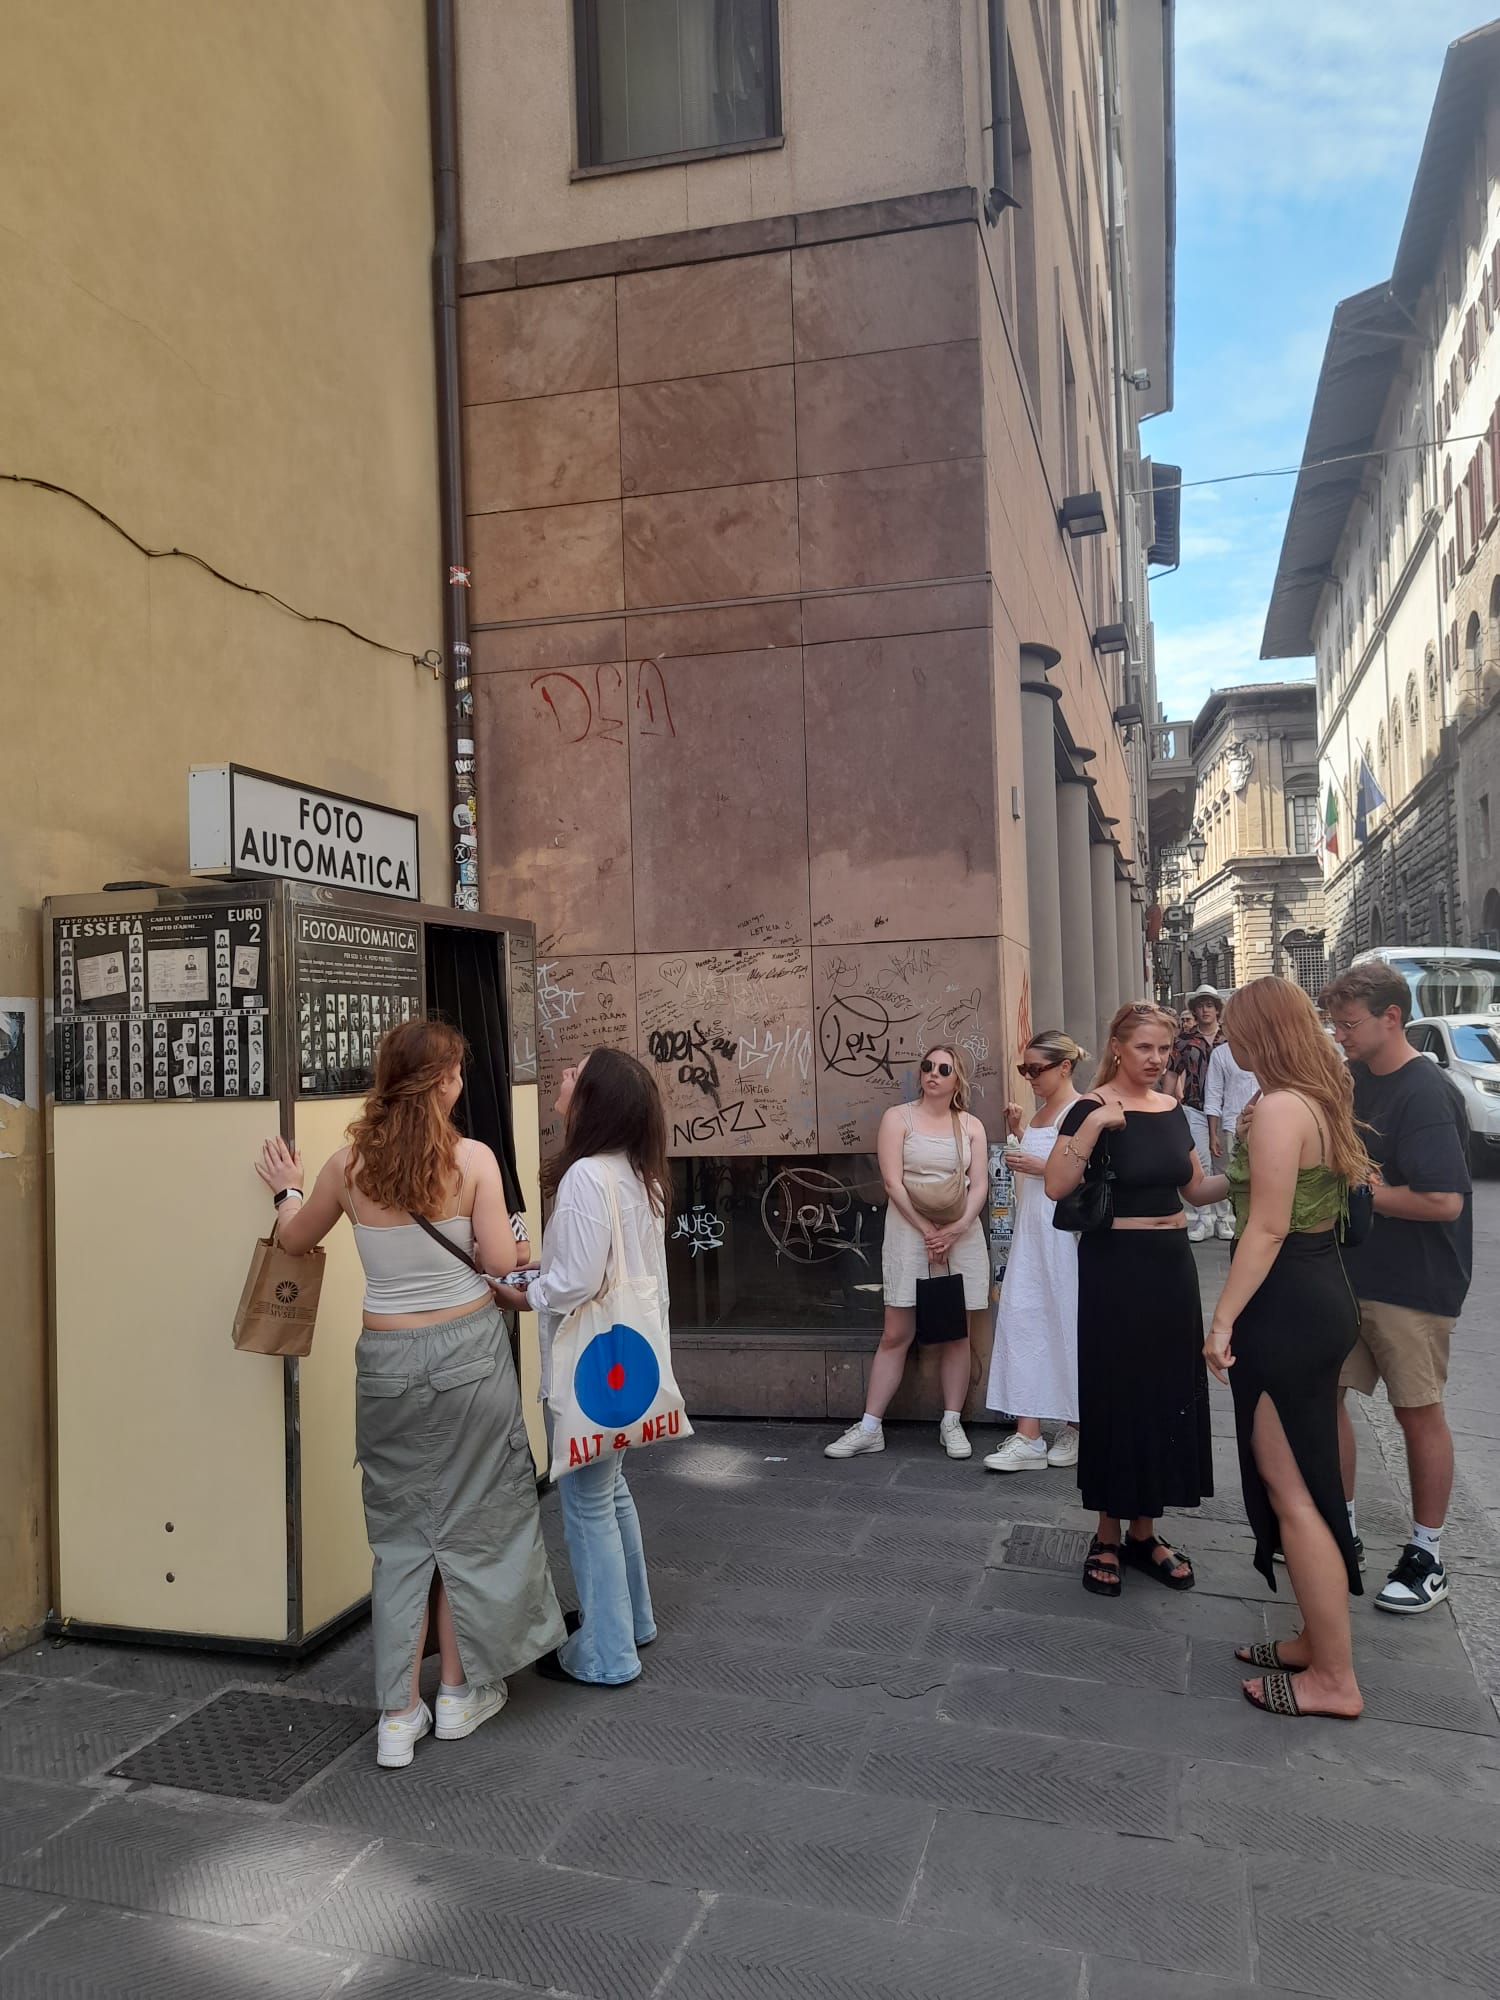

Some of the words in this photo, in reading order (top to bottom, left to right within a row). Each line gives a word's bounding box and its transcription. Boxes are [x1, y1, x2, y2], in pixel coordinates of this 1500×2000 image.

[299, 797, 364, 844] FOTO
[240, 827, 411, 892] AUTOMATICA
[1161, 847, 1186, 855] HOTEL
[86, 915, 121, 923] VALIDE
[227, 908, 262, 922] EURO
[60, 920, 143, 938] TESSERA
[248, 923, 261, 943] 2
[302, 919, 416, 950] FOTOAUTOMATICA
[592, 1024, 628, 1036] FIRENZE
[569, 1433, 604, 1467] ALT
[612, 1432, 632, 1450] &
[641, 1409, 679, 1443] NEU
